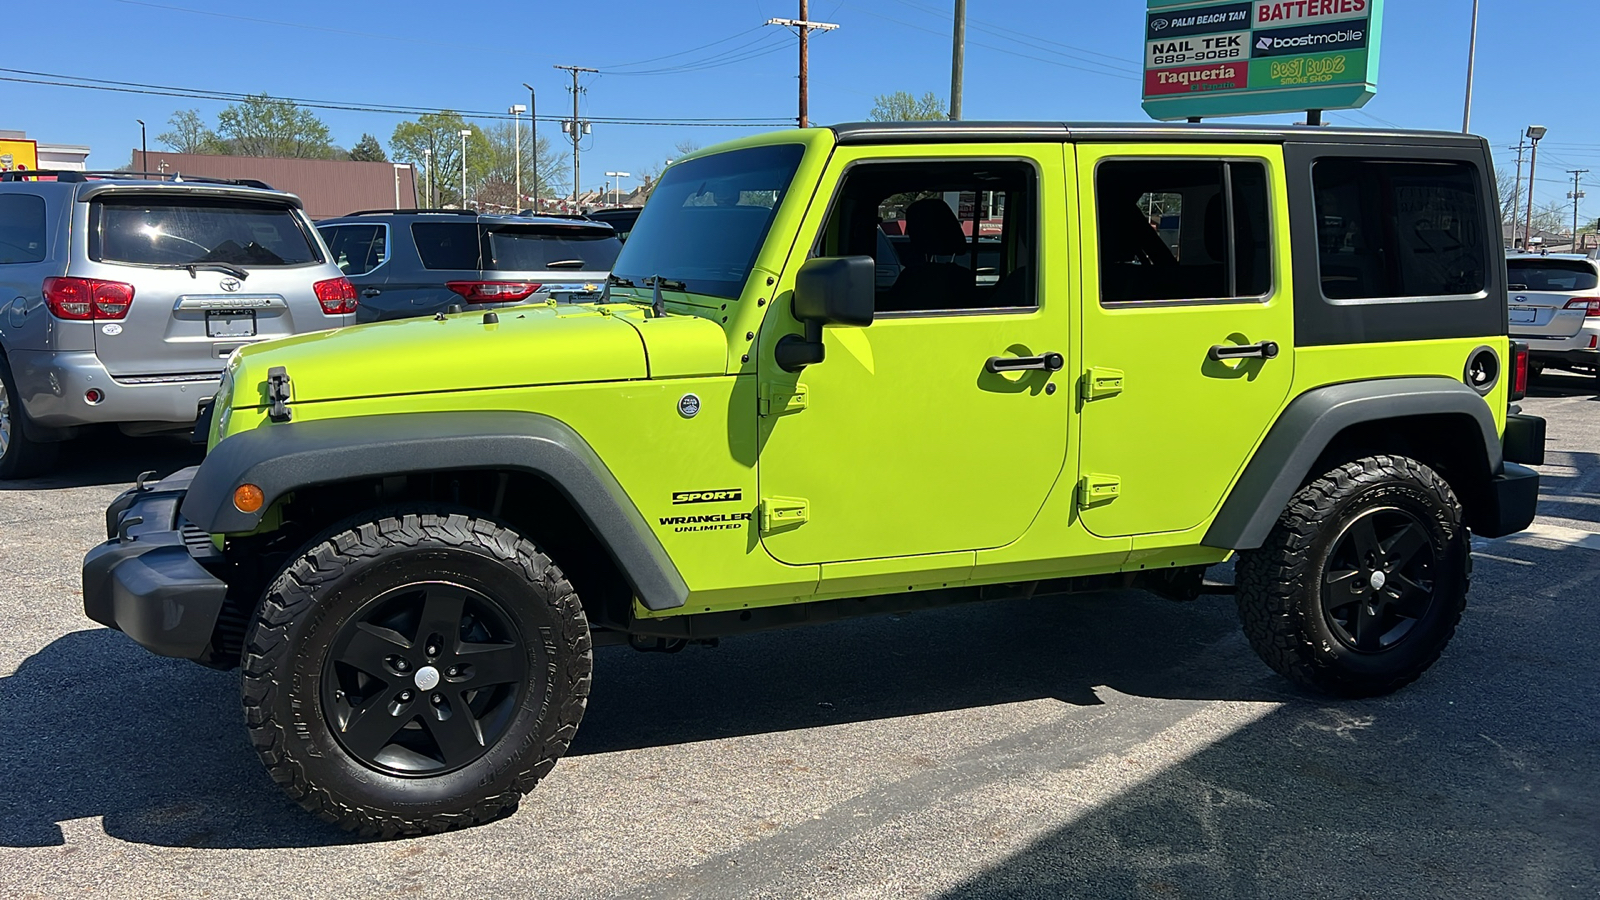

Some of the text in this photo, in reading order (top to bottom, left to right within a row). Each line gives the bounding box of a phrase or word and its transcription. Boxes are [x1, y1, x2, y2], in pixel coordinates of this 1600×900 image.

[1171, 10, 1247, 28] PALM BEACH TAN
[1259, 0, 1366, 22] BATTERIES
[1152, 35, 1242, 55] NAIL TEK
[1273, 30, 1363, 48] boostmobile
[1154, 48, 1240, 65] 689-9088
[1281, 74, 1333, 85] SMOKE SHOP
[676, 490, 738, 502] SPORT
[659, 512, 752, 525] WRANGLER
[674, 523, 742, 533] UNLIMITED
